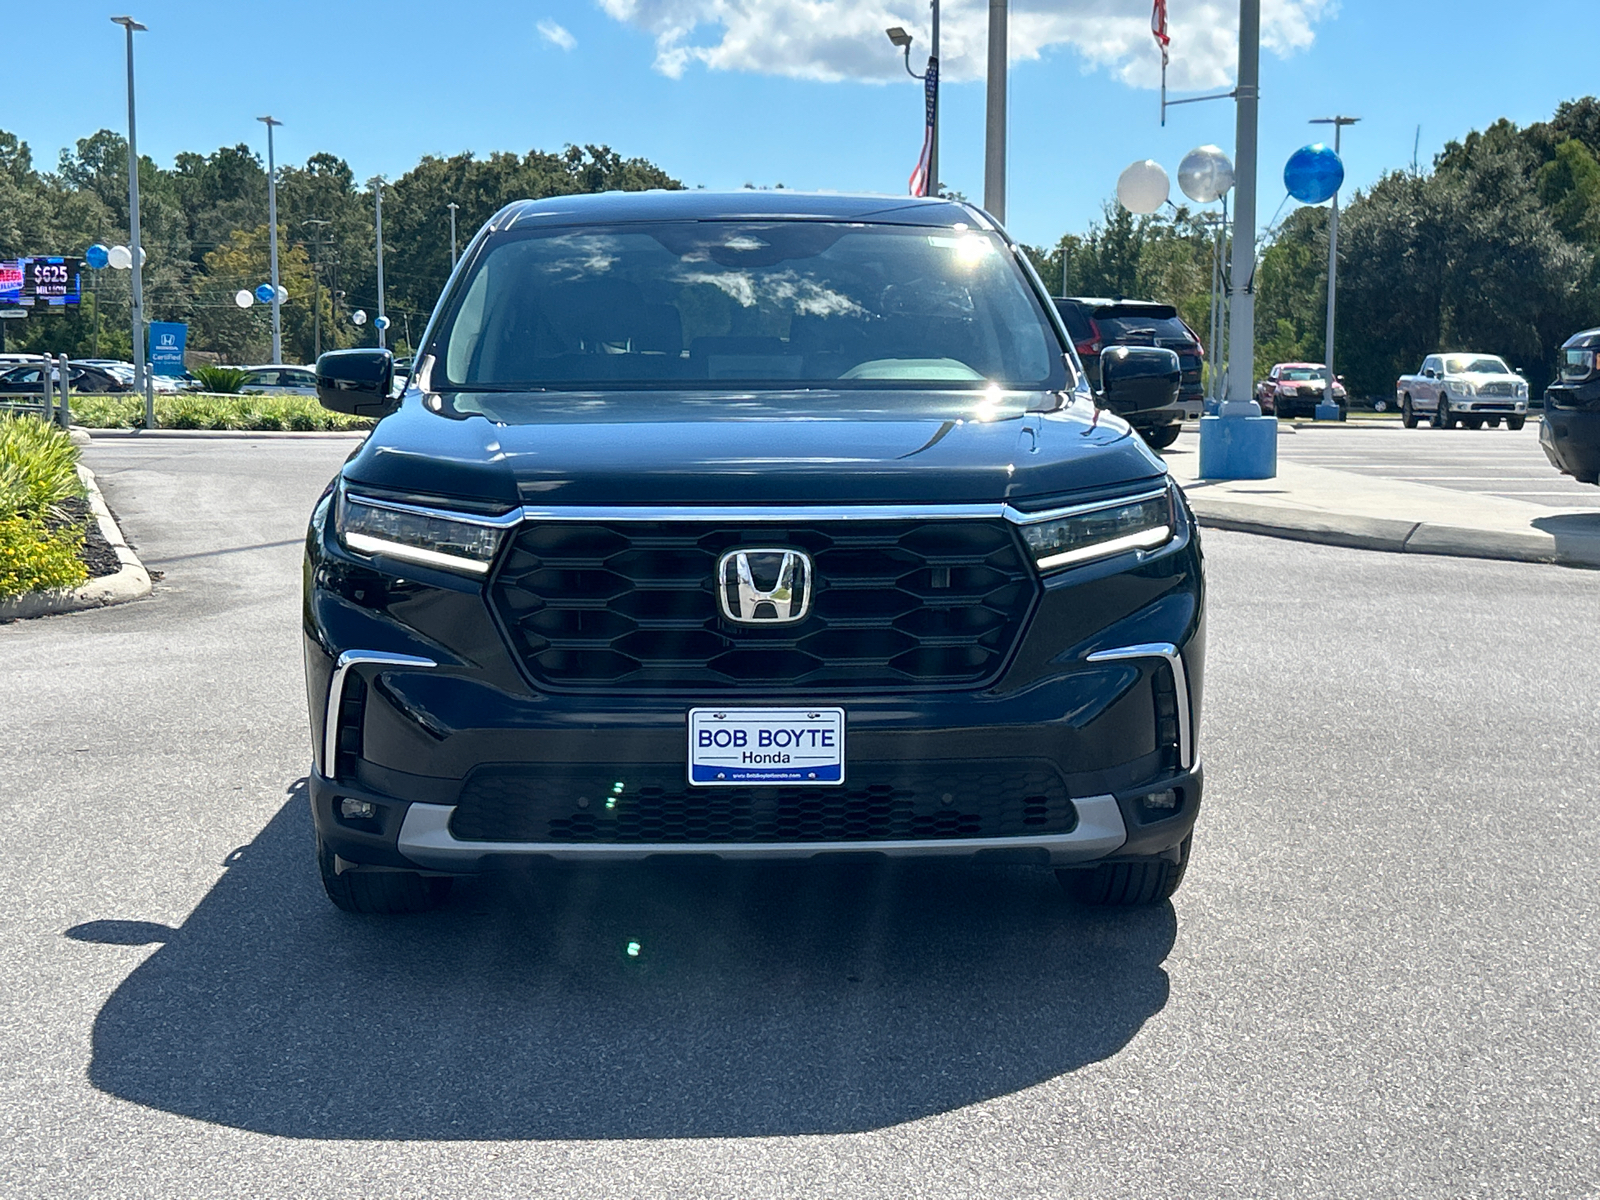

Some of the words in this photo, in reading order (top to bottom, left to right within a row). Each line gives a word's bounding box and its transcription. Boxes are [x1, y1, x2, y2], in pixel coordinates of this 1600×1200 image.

[34, 265, 68, 284] $625
[698, 729, 748, 748] BOB
[758, 729, 835, 748] BOYTE
[742, 751, 791, 764] Honda
